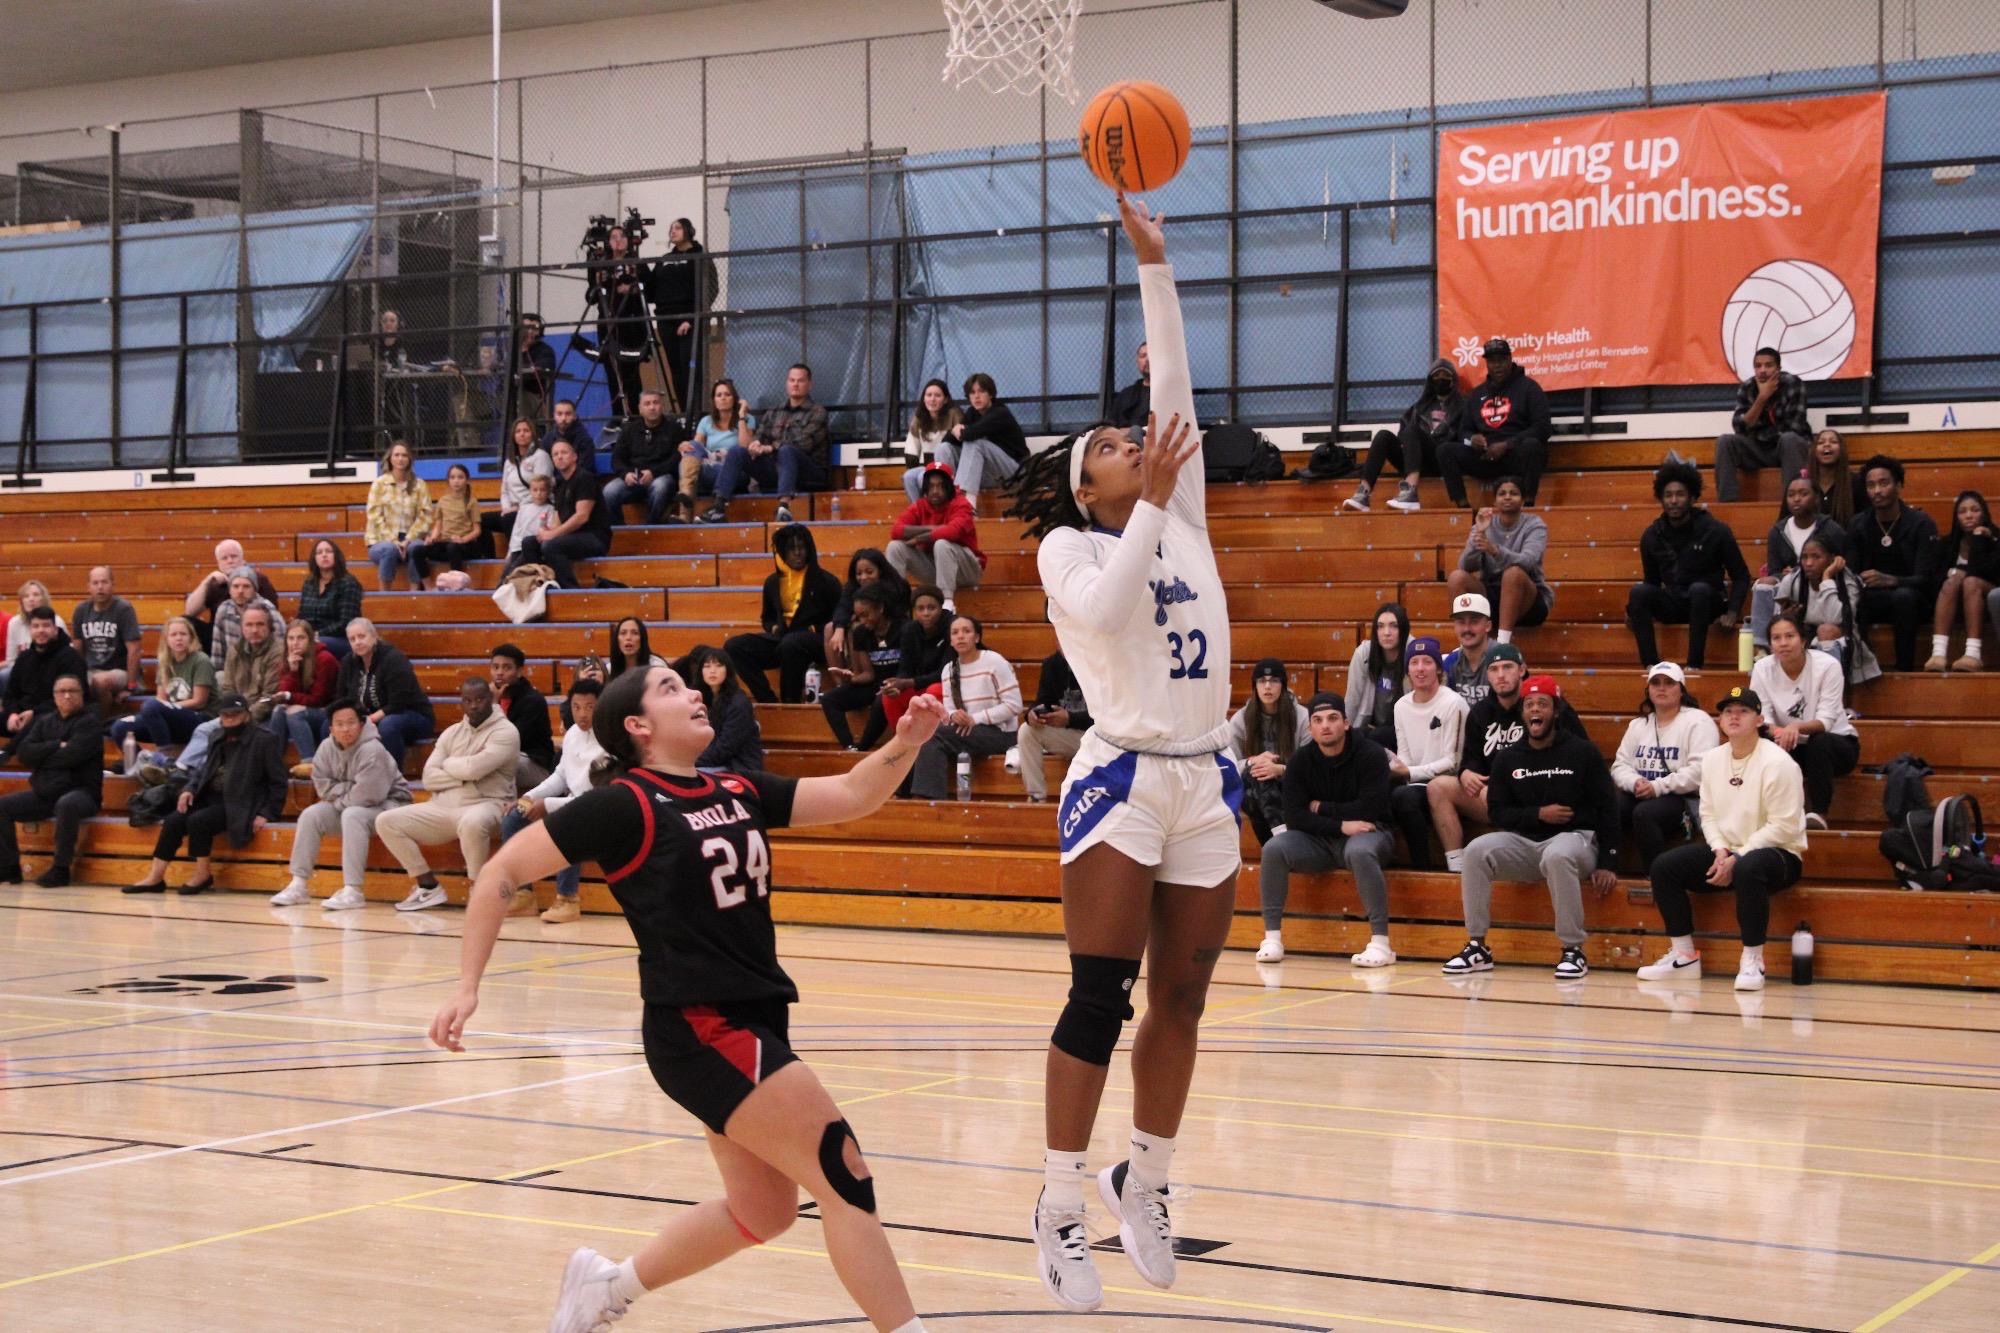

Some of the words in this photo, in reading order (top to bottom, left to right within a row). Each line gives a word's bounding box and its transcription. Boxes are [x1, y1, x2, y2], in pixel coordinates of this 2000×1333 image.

[1456, 136, 1614, 187] Serving
[1623, 136, 1679, 179] up
[1455, 177, 1803, 241] humankindness.
[1546, 327, 1590, 346] Health
[1542, 350, 1575, 362] Hospital
[1575, 348, 1585, 359] of
[1601, 345, 1649, 357] Bernardino
[1580, 359, 1608, 370] Center
[1941, 405, 1957, 428] A
[81, 621, 118, 639] EAGLES
[1166, 628, 1208, 680] 32
[1511, 767, 1575, 780] Champion
[681, 798, 752, 832] BIOLA
[700, 828, 770, 910] 24
